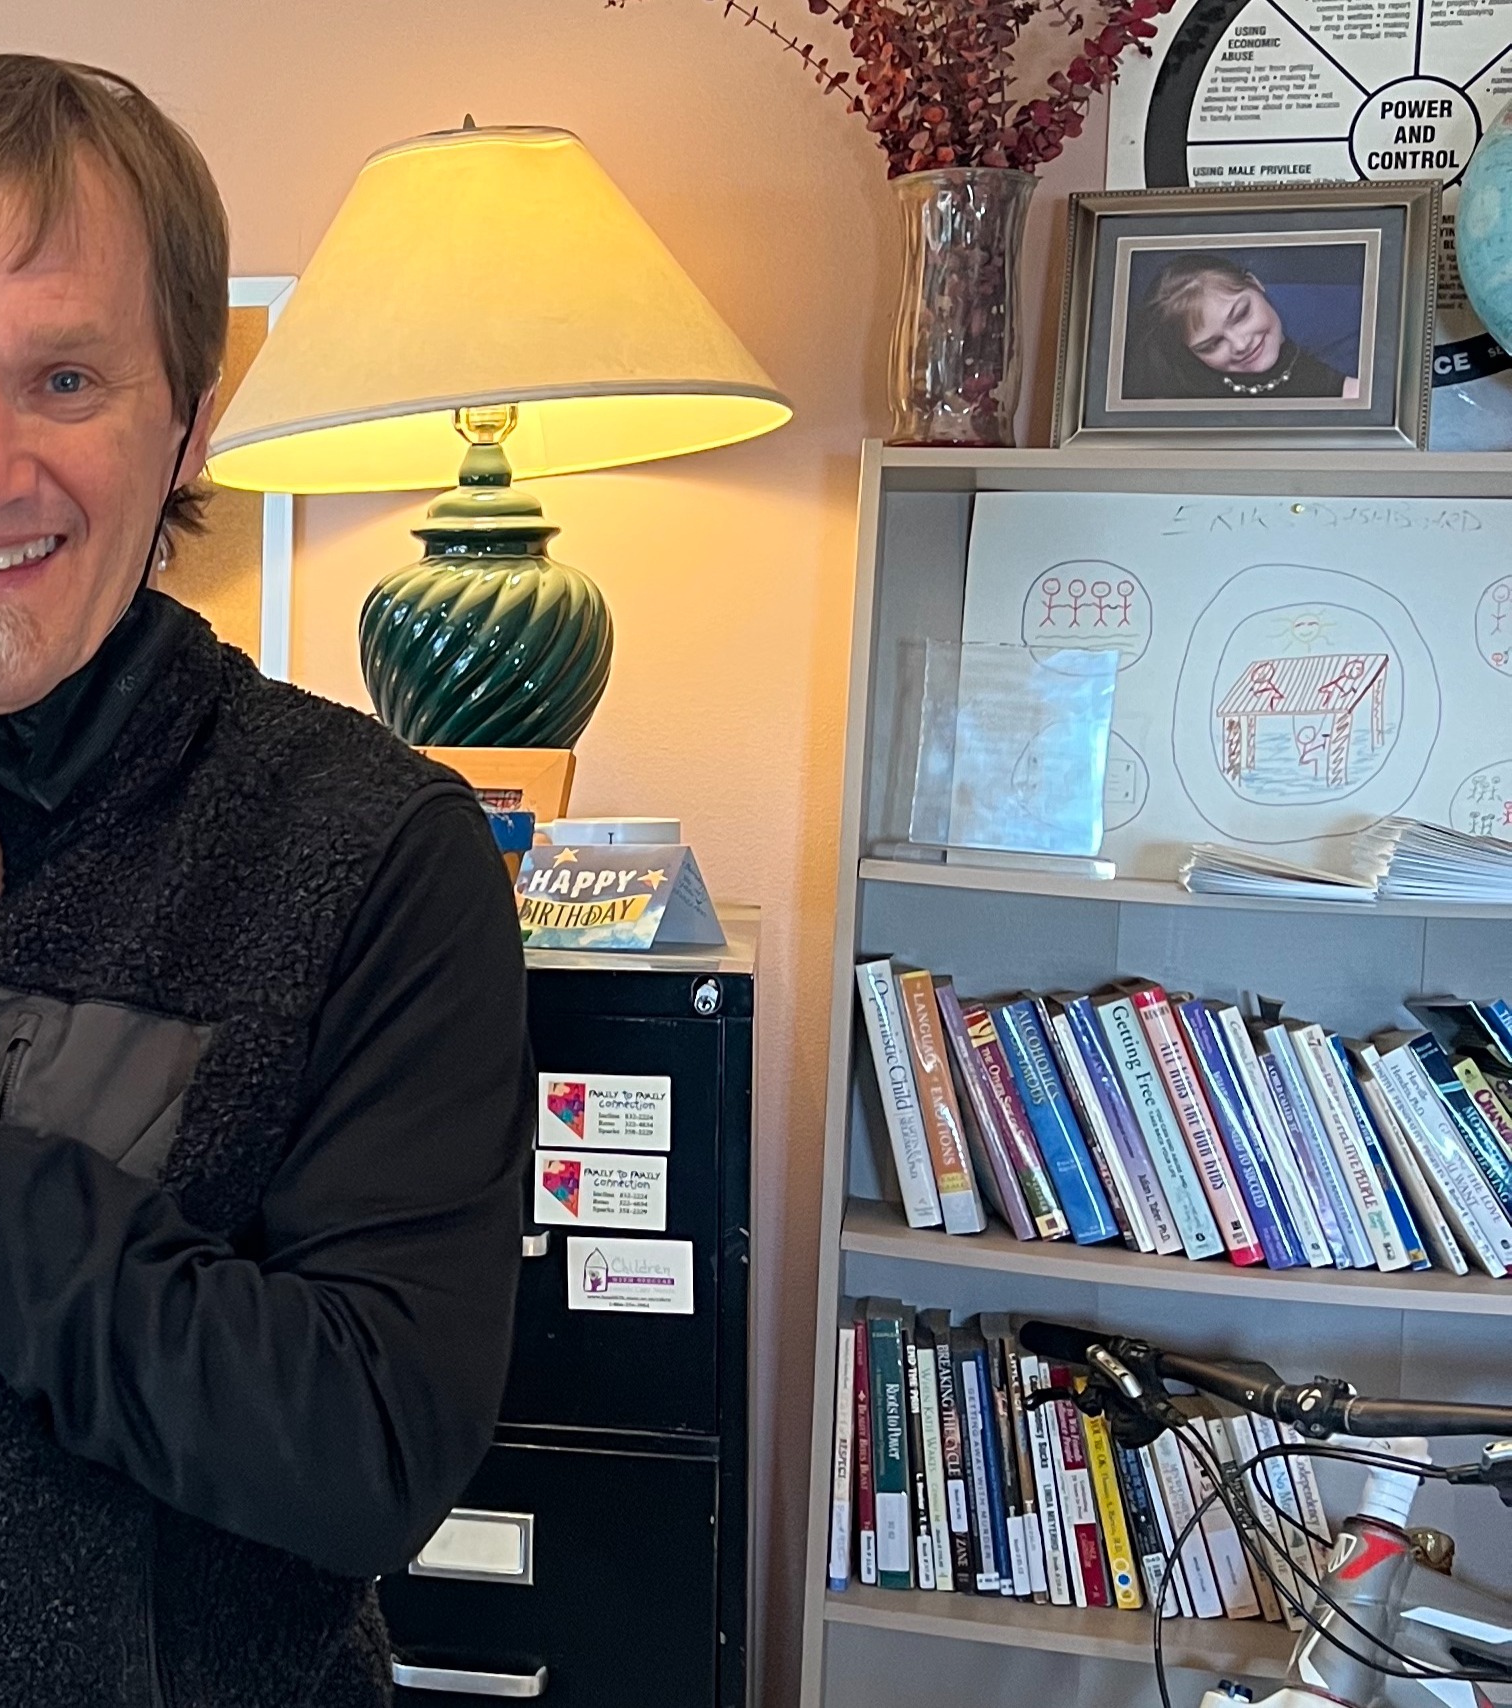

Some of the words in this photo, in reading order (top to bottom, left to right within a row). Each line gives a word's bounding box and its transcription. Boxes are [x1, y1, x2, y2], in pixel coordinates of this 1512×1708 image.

[1228, 38, 1281, 49] ECONOMIC
[1235, 26, 1266, 36] USING
[1221, 52, 1254, 61] ABUSE
[1381, 99, 1453, 120] POWER
[1394, 126, 1436, 144] AND
[1193, 167, 1223, 176] USING
[1228, 166, 1255, 175] MALE
[1260, 164, 1311, 174] PRIVILEGE
[1367, 149, 1459, 172] CONTROL
[529, 869, 637, 898] HAPPY
[519, 898, 636, 928] BIRTHDAY
[1016, 1006, 1060, 1101] ALCOHOLICS
[1111, 1004, 1142, 1071] Getting
[1135, 1070, 1156, 1107] Free
[889, 1064, 912, 1110] Child
[1242, 1165, 1266, 1208] SUCCEED
[1353, 1167, 1377, 1209] PEOPLE
[1452, 1173, 1478, 1210] WANT
[1479, 1193, 1502, 1224] LOVE
[611, 1257, 670, 1275] Children
[908, 1367, 917, 1387] THE
[935, 1344, 953, 1407] BREAKING
[885, 1383, 899, 1413] Roots
[967, 1387, 977, 1437] GETTING
[920, 1367, 932, 1402] WHEN
[926, 1435, 938, 1472] WAKES
[942, 1409, 956, 1435] THE
[837, 1438, 846, 1477] RESPECT
[887, 1427, 901, 1460] Power
[944, 1435, 960, 1476] CYCLE
[973, 1440, 981, 1470] AWAY
[1038, 1441, 1049, 1468] Sucks
[976, 1477, 985, 1506] WITH
[1043, 1483, 1053, 1507] LINDA
[1274, 1471, 1289, 1489] No
[980, 1510, 991, 1559] MURDER
[955, 1538, 967, 1566] ZANE
